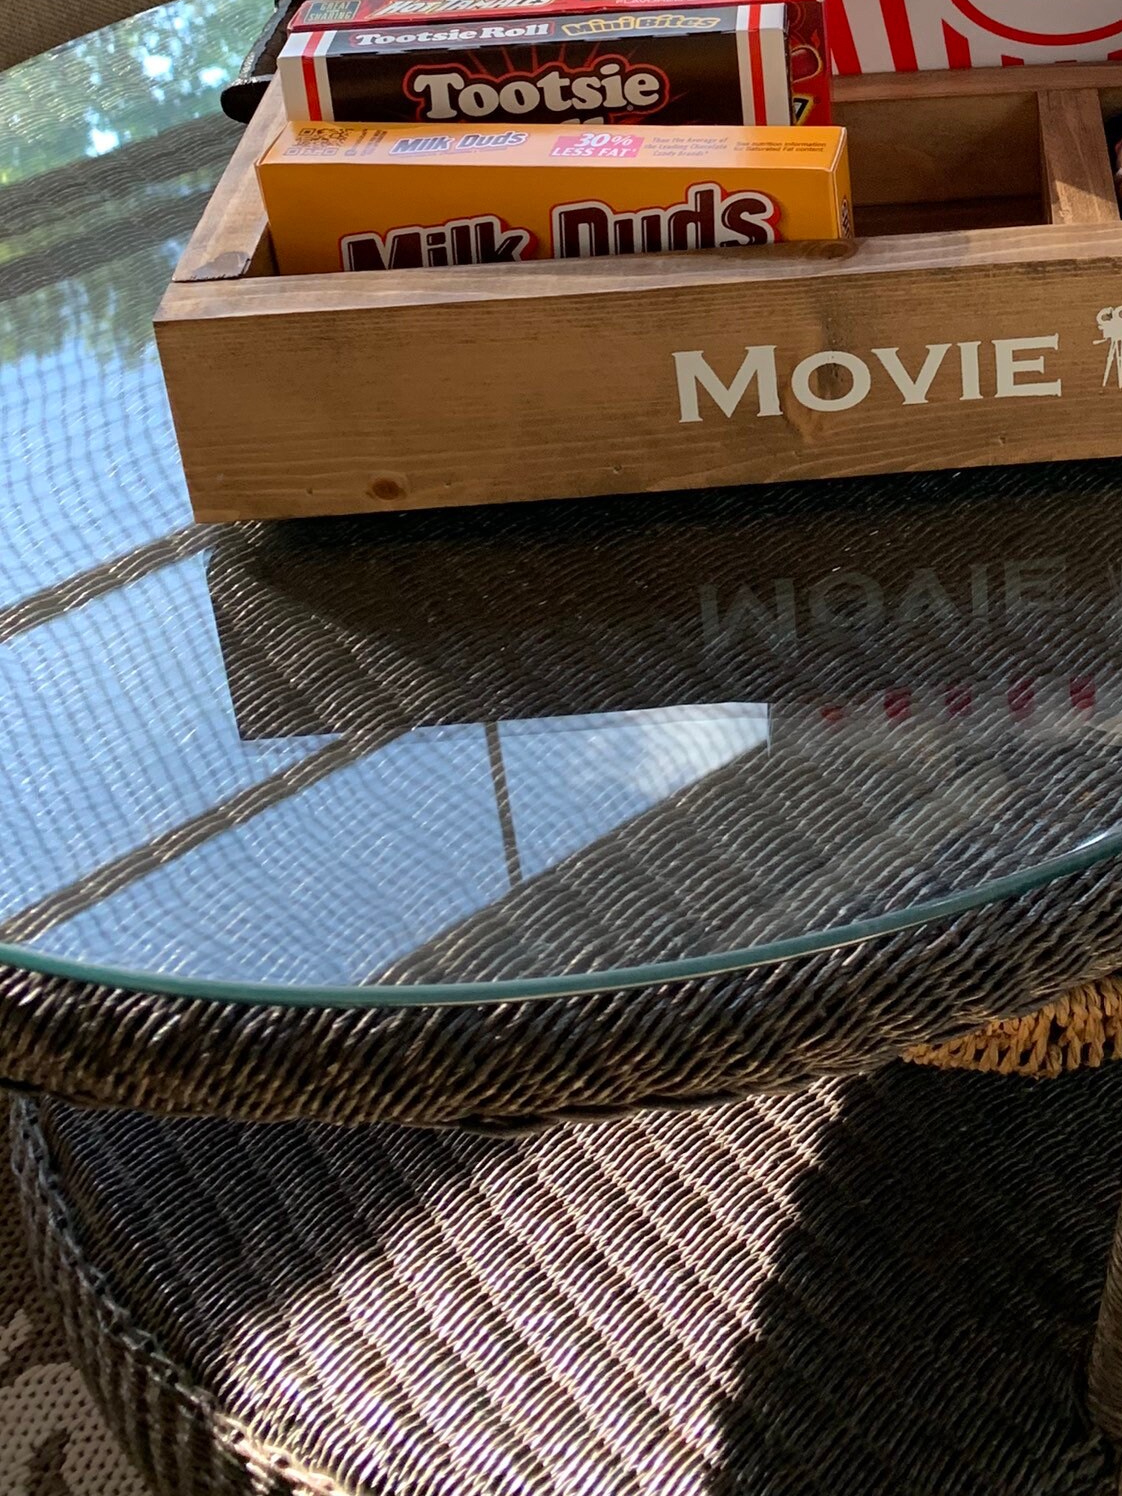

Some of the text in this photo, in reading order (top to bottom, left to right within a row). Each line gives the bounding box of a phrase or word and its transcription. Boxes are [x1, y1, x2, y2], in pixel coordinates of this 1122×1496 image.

[308, 11, 352, 21] SHARING
[355, 13, 722, 46] Tootsie Roll Mini Bites
[413, 63, 660, 120] Tootsie
[390, 136, 455, 155] Milk
[456, 131, 529, 151] Duds
[551, 147, 595, 156] LESS
[574, 133, 634, 149] 30%
[672, 333, 1062, 423] MOVIE
